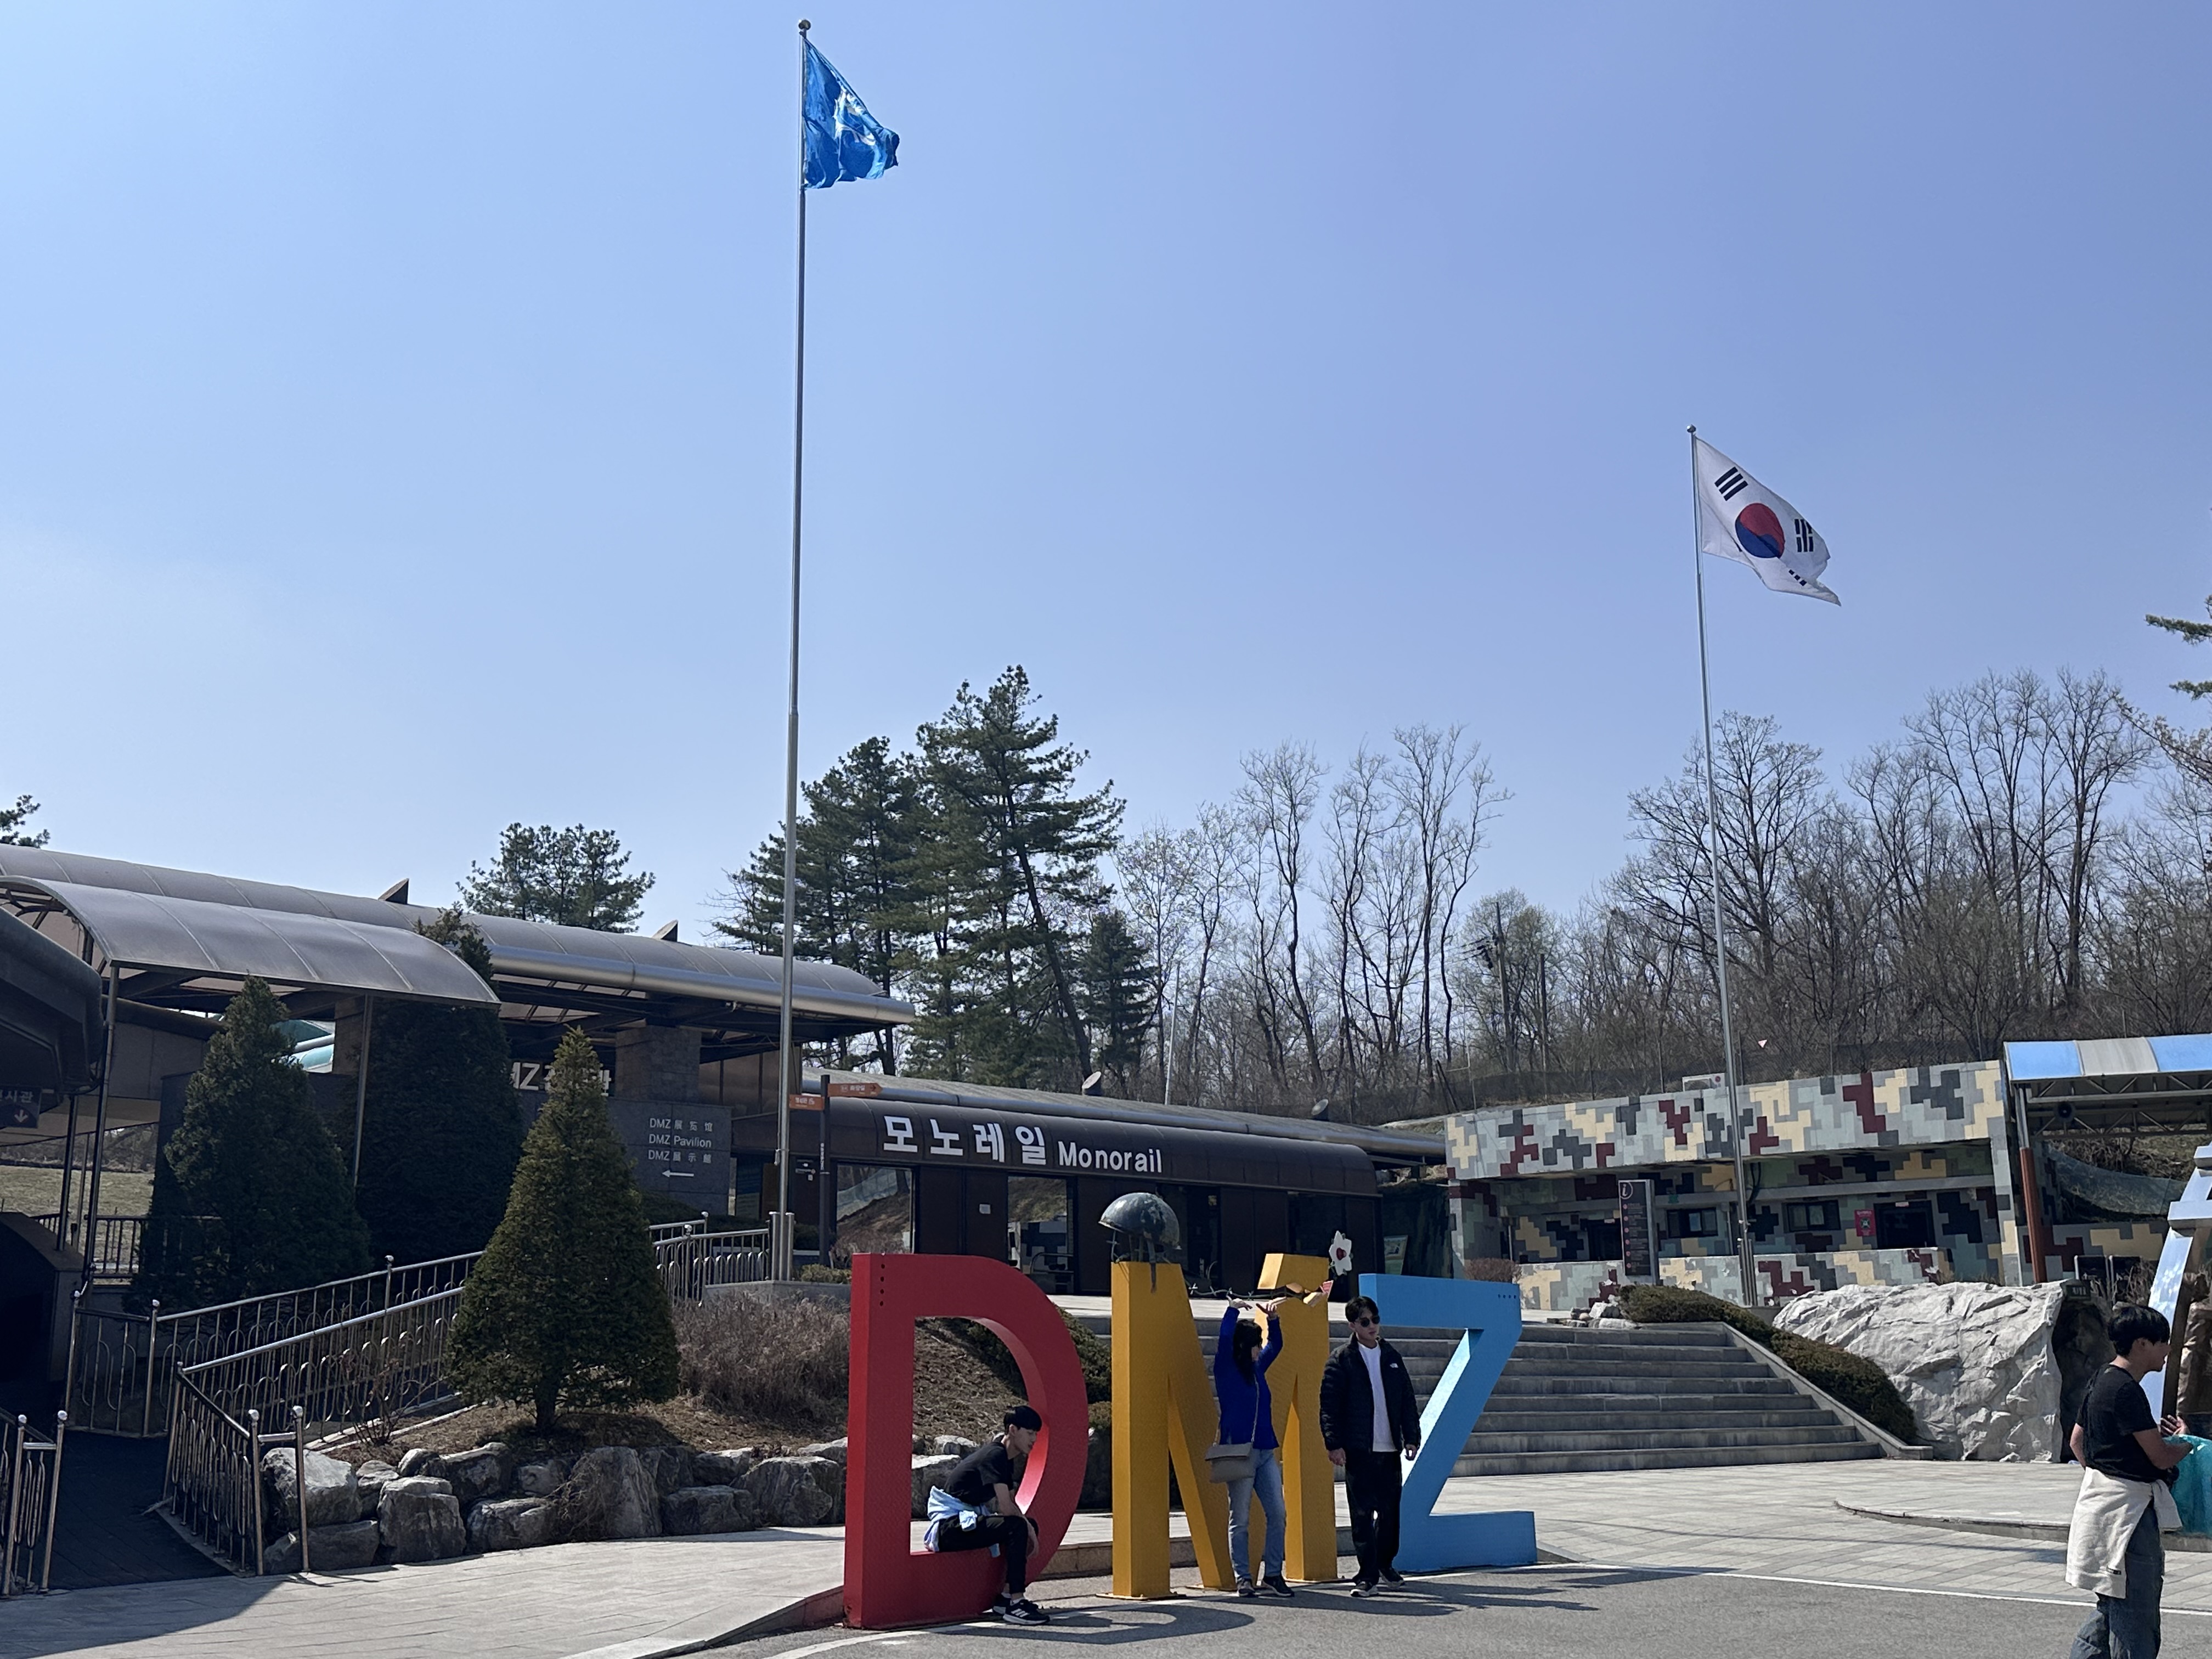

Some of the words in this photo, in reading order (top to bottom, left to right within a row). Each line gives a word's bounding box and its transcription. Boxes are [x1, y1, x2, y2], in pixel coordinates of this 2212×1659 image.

[649, 1118, 671, 1129] DMZ
[648, 1133, 670, 1145] DMZ
[674, 1136, 712, 1148] Pavilion
[883, 1115, 1047, 1165] 모노레일
[1057, 1141, 1163, 1173] Monorail
[648, 1149, 670, 1161] DMZ
[844, 1253, 1536, 1629] DMZ
